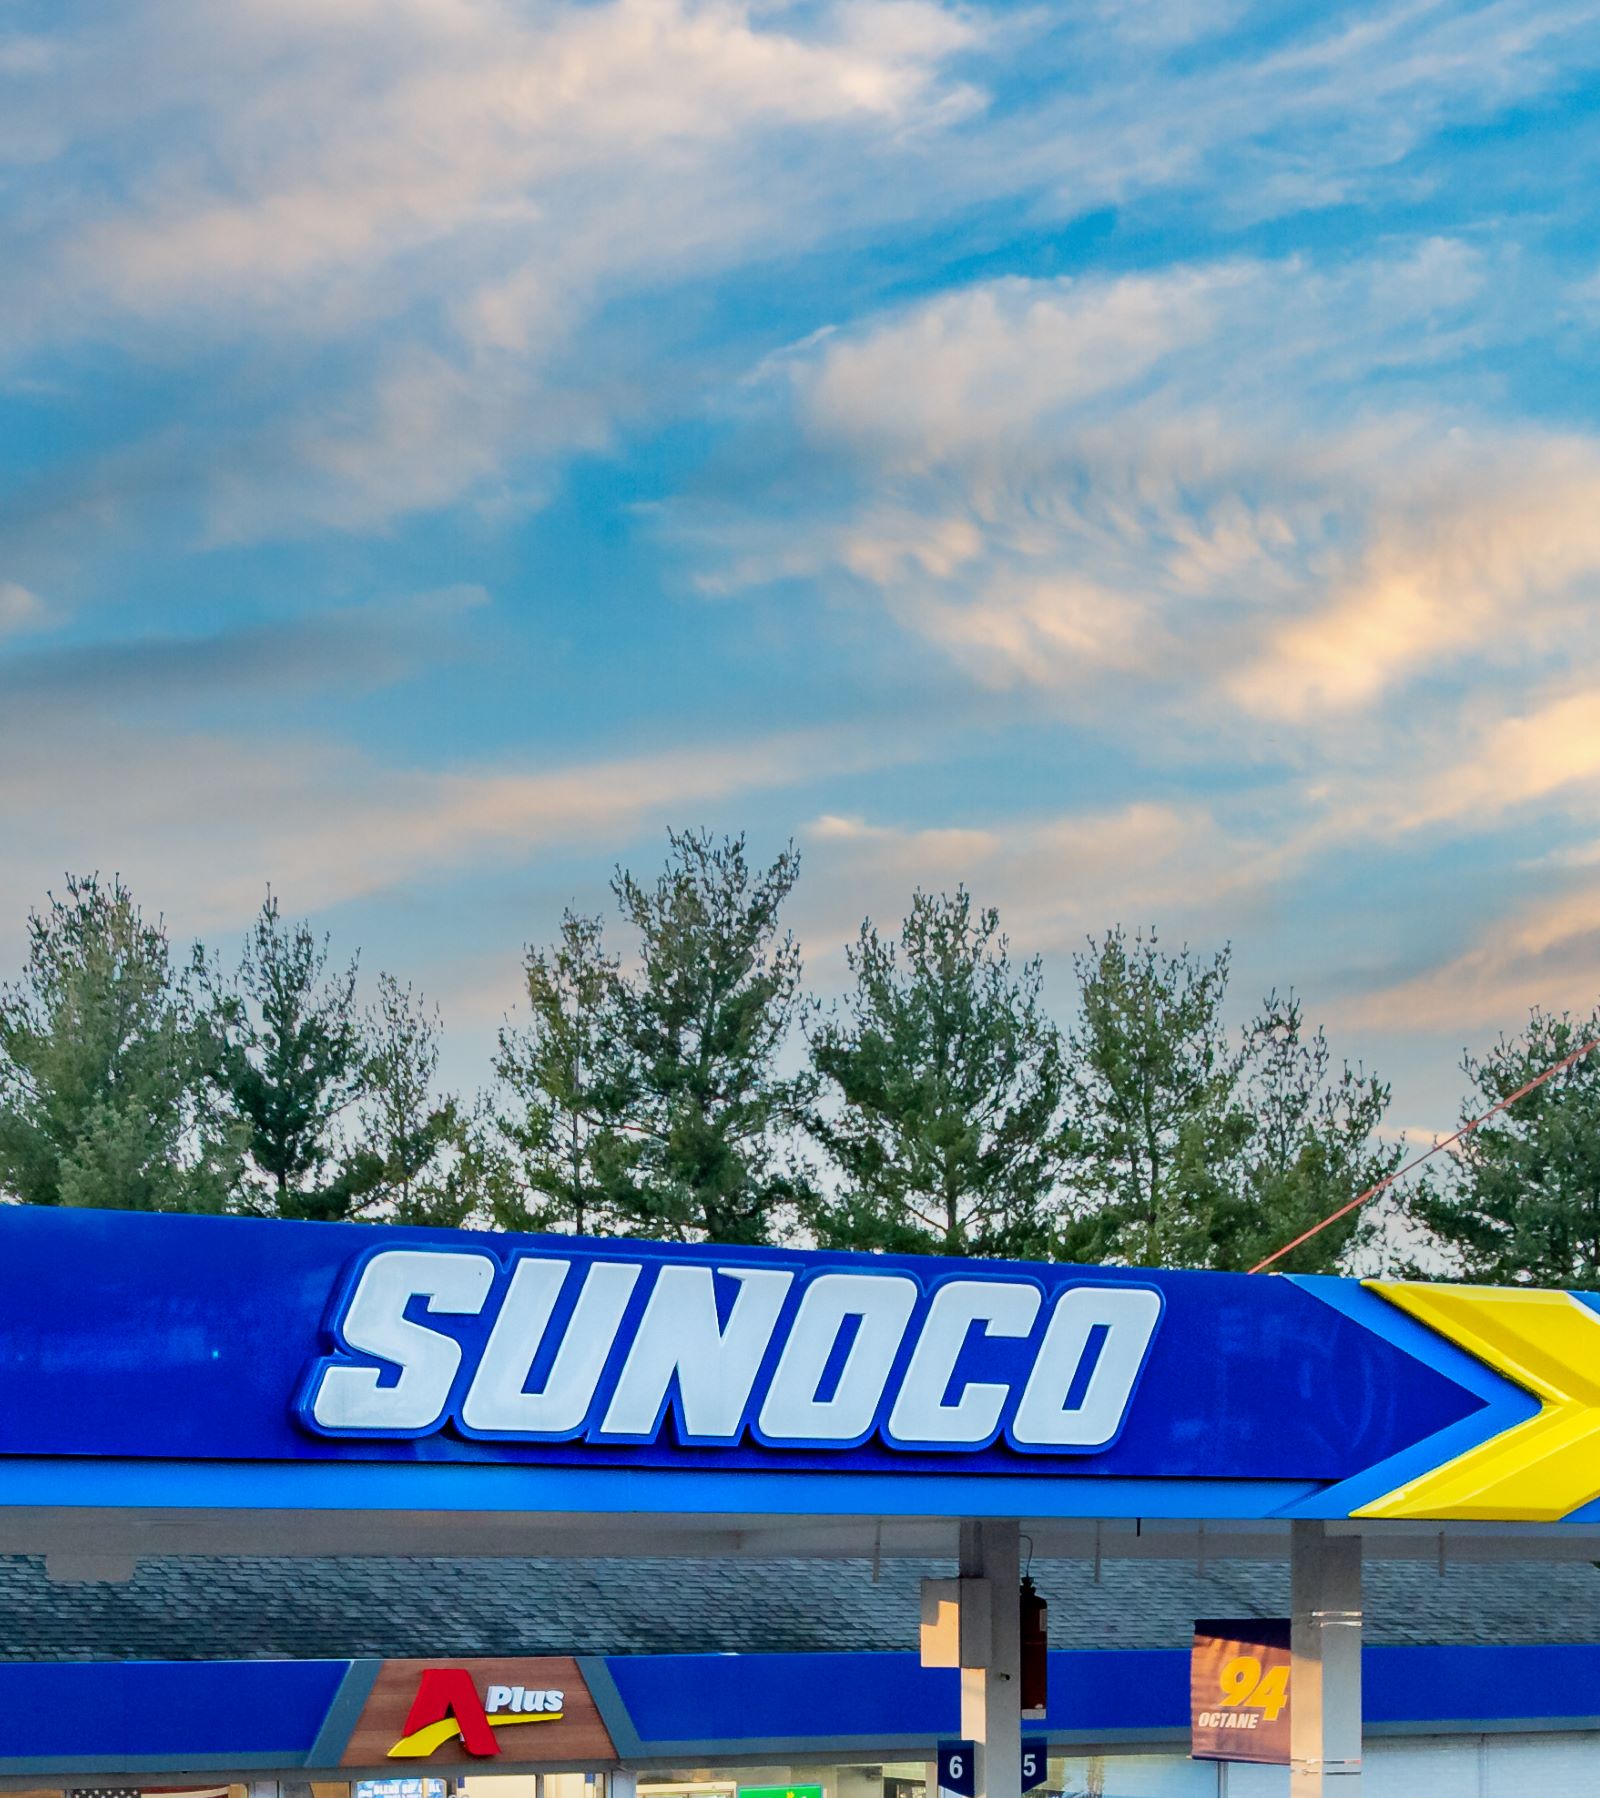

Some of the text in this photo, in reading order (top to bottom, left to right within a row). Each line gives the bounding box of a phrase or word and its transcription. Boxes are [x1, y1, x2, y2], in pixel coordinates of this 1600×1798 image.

[311, 1250, 1164, 1446] SUNOCO
[485, 1685, 564, 1713] Plus
[1218, 1656, 1291, 1722] 94
[1199, 1712, 1259, 1729] OCTANE
[949, 1755, 963, 1779] 6
[1023, 1753, 1037, 1777] 5
